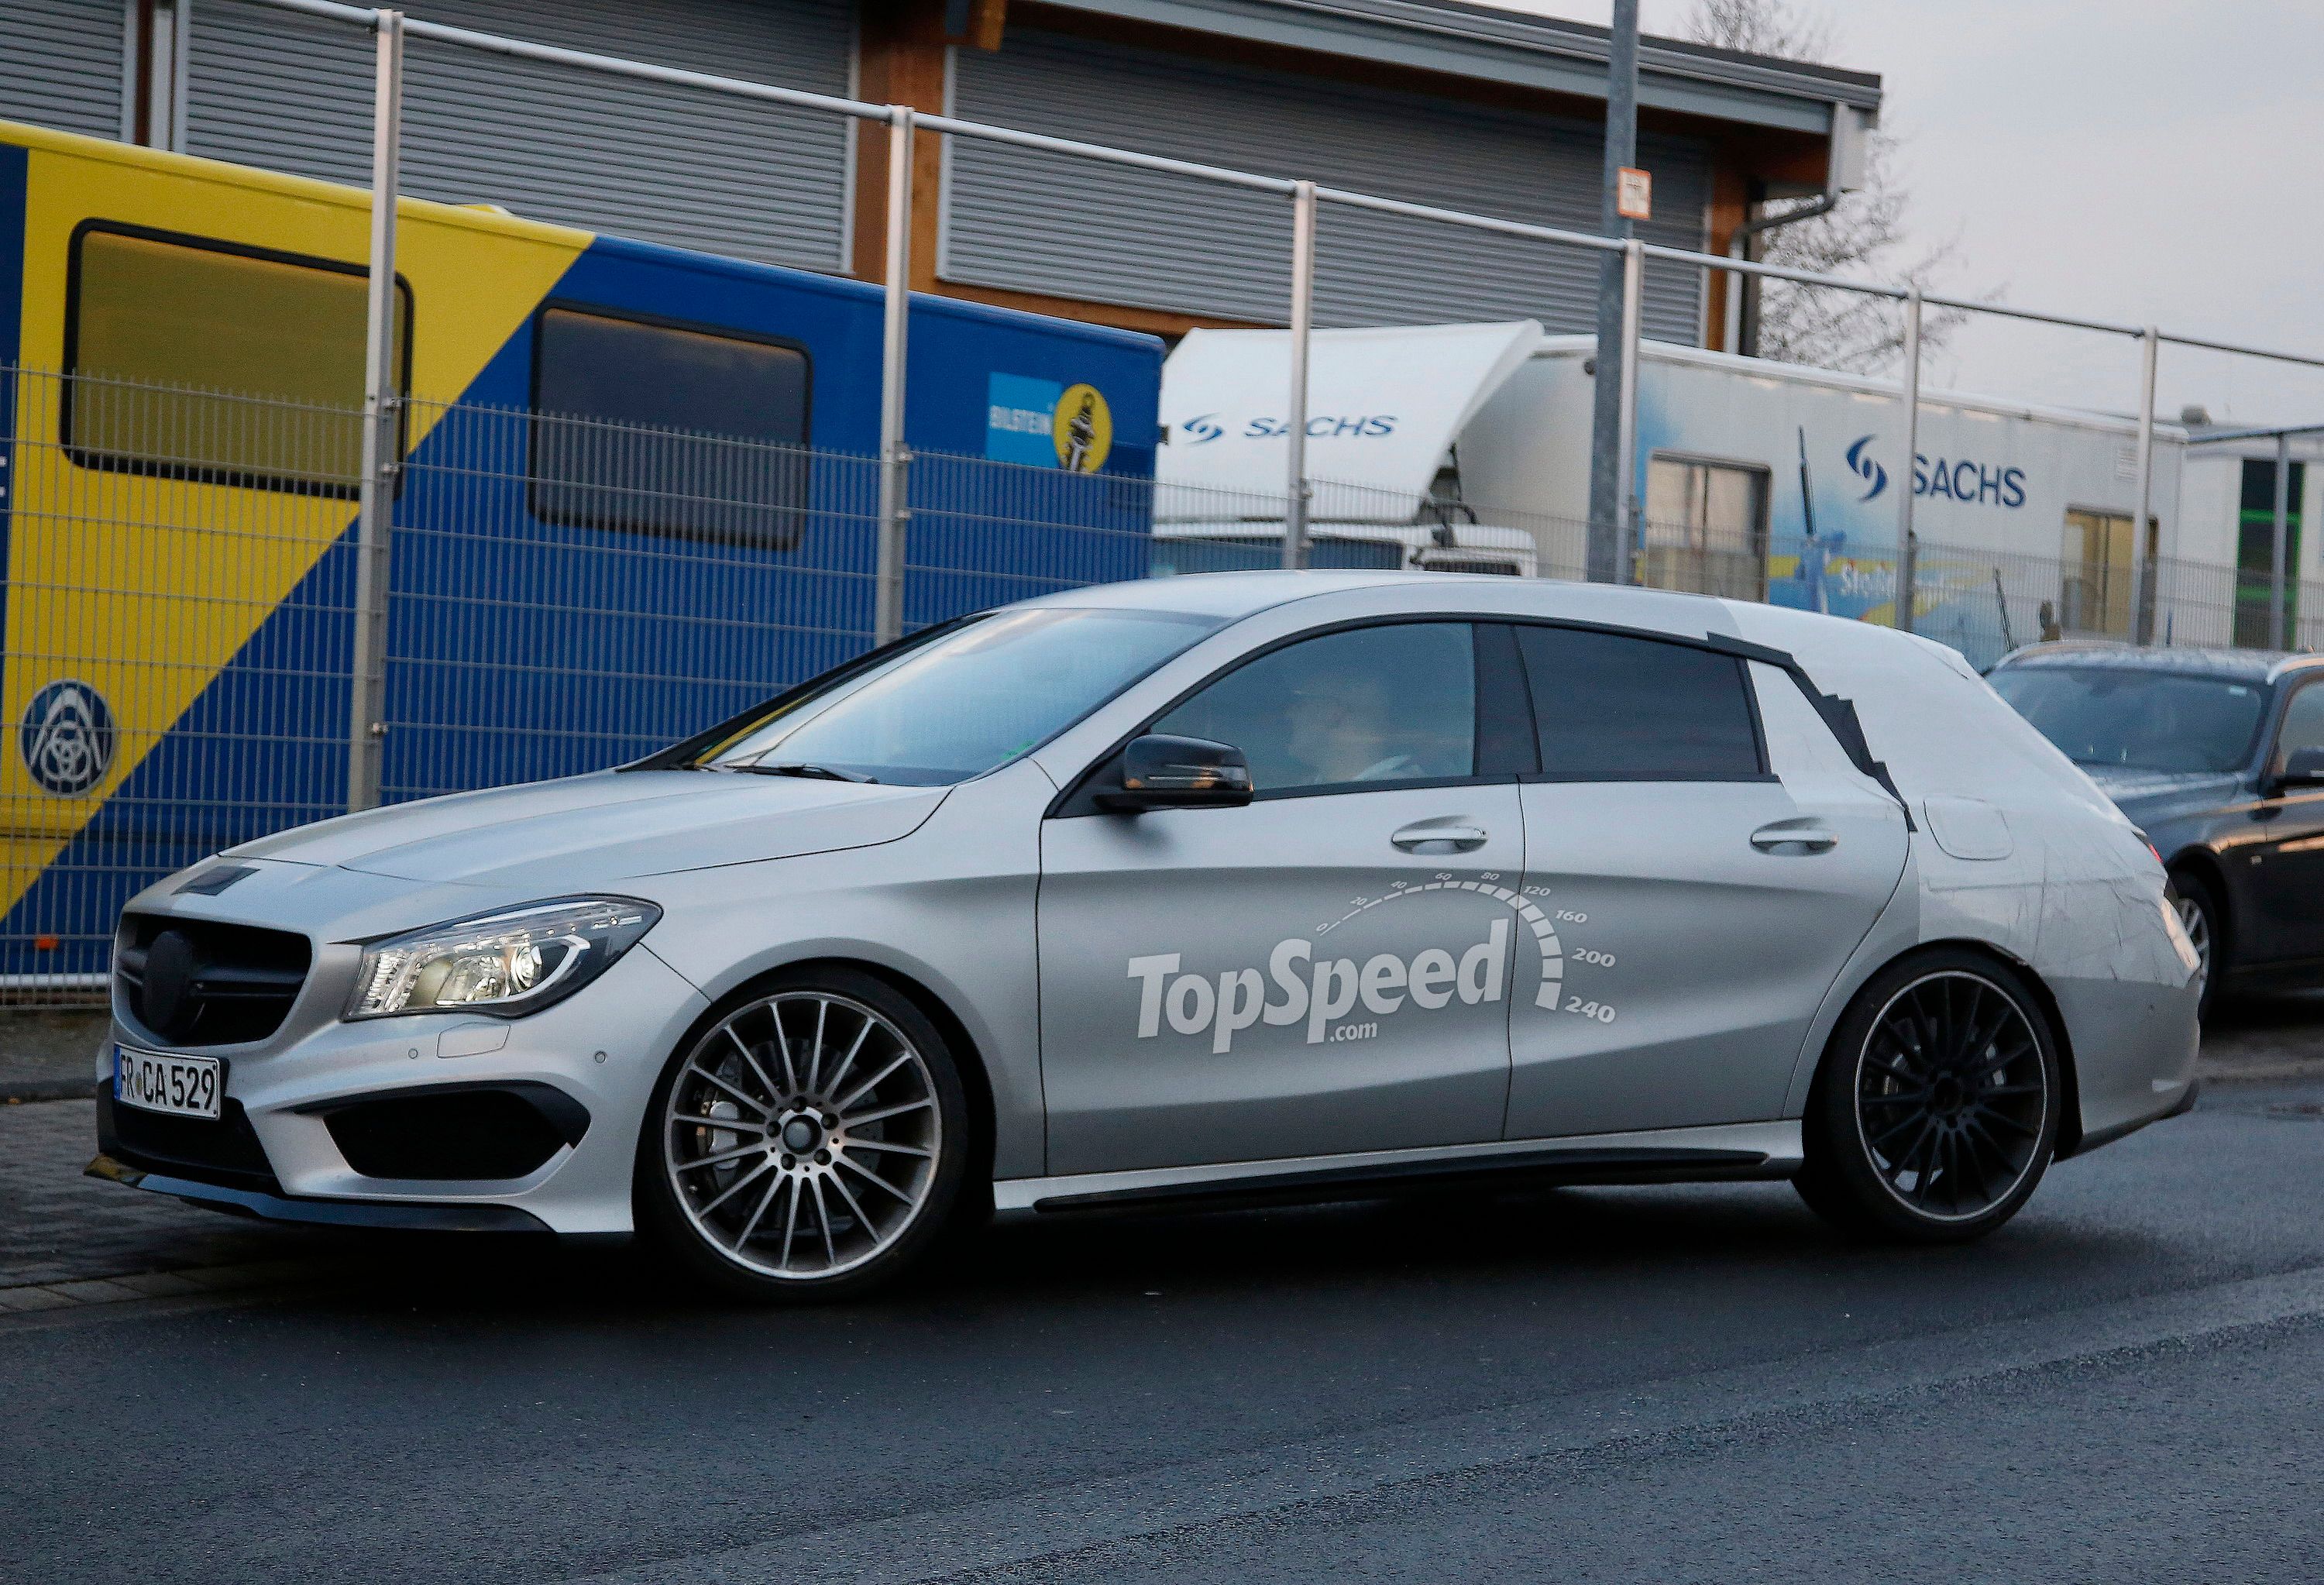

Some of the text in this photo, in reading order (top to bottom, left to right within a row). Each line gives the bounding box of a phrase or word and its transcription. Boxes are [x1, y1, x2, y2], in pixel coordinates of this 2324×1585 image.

[1913, 452, 2027, 507] SACHS
[120, 1054, 215, 1110] FR CA 529
